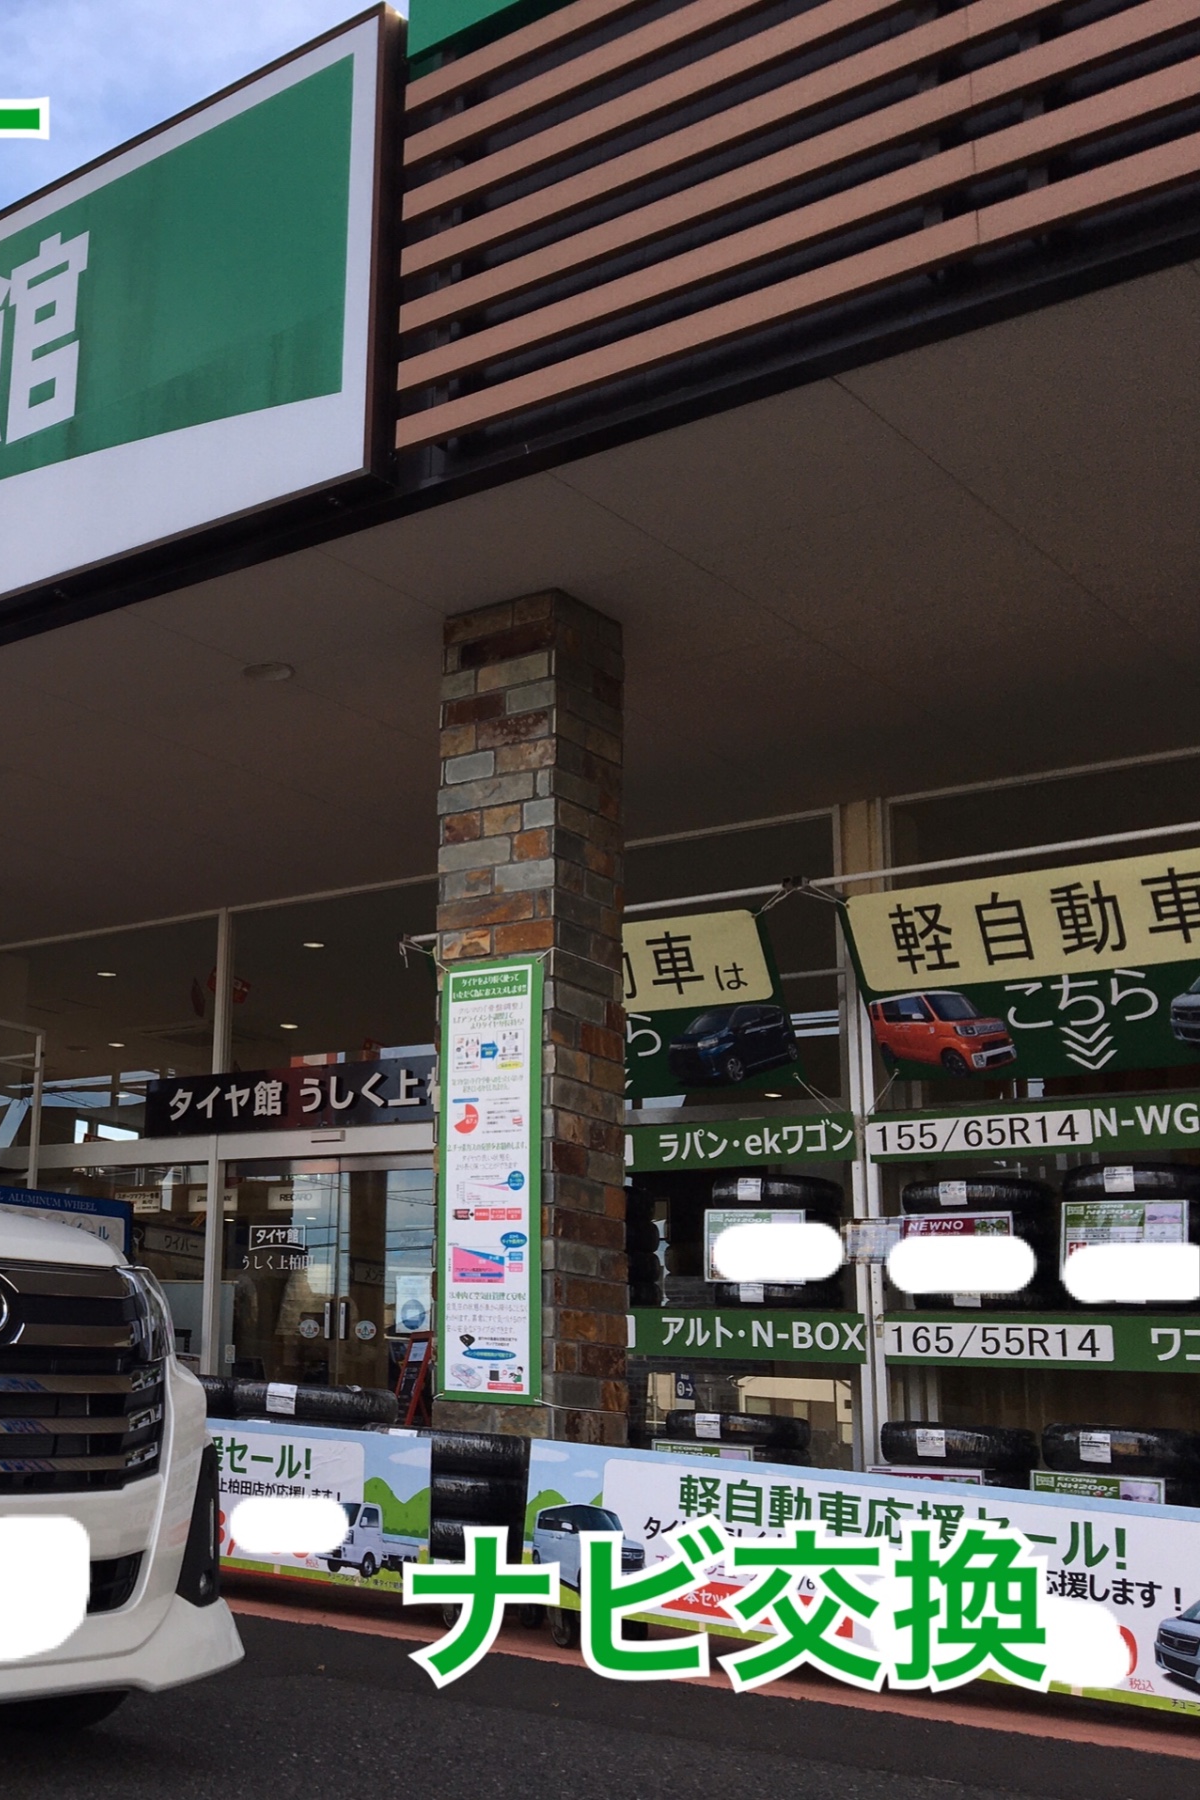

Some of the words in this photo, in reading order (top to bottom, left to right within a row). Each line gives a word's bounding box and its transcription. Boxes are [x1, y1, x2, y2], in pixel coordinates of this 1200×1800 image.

[888, 867, 1200, 976] 軽自動車
[1005, 968, 1159, 1029] こちら
[169, 1080, 283, 1121] タイヤ館
[875, 1112, 1081, 1153] 155/65R14
[1093, 1102, 1200, 1138] N-WG
[8, 1193, 61, 1208] ALUMINUM
[64, 1200, 98, 1212] WHEEL
[255, 1229, 300, 1244] タイヤ館
[907, 1220, 964, 1232] NEWNO
[661, 1315, 867, 1352] アルト・N-BOX
[890, 1324, 1100, 1359] 165/55R14
[1128, 1677, 1155, 1693] 税込
